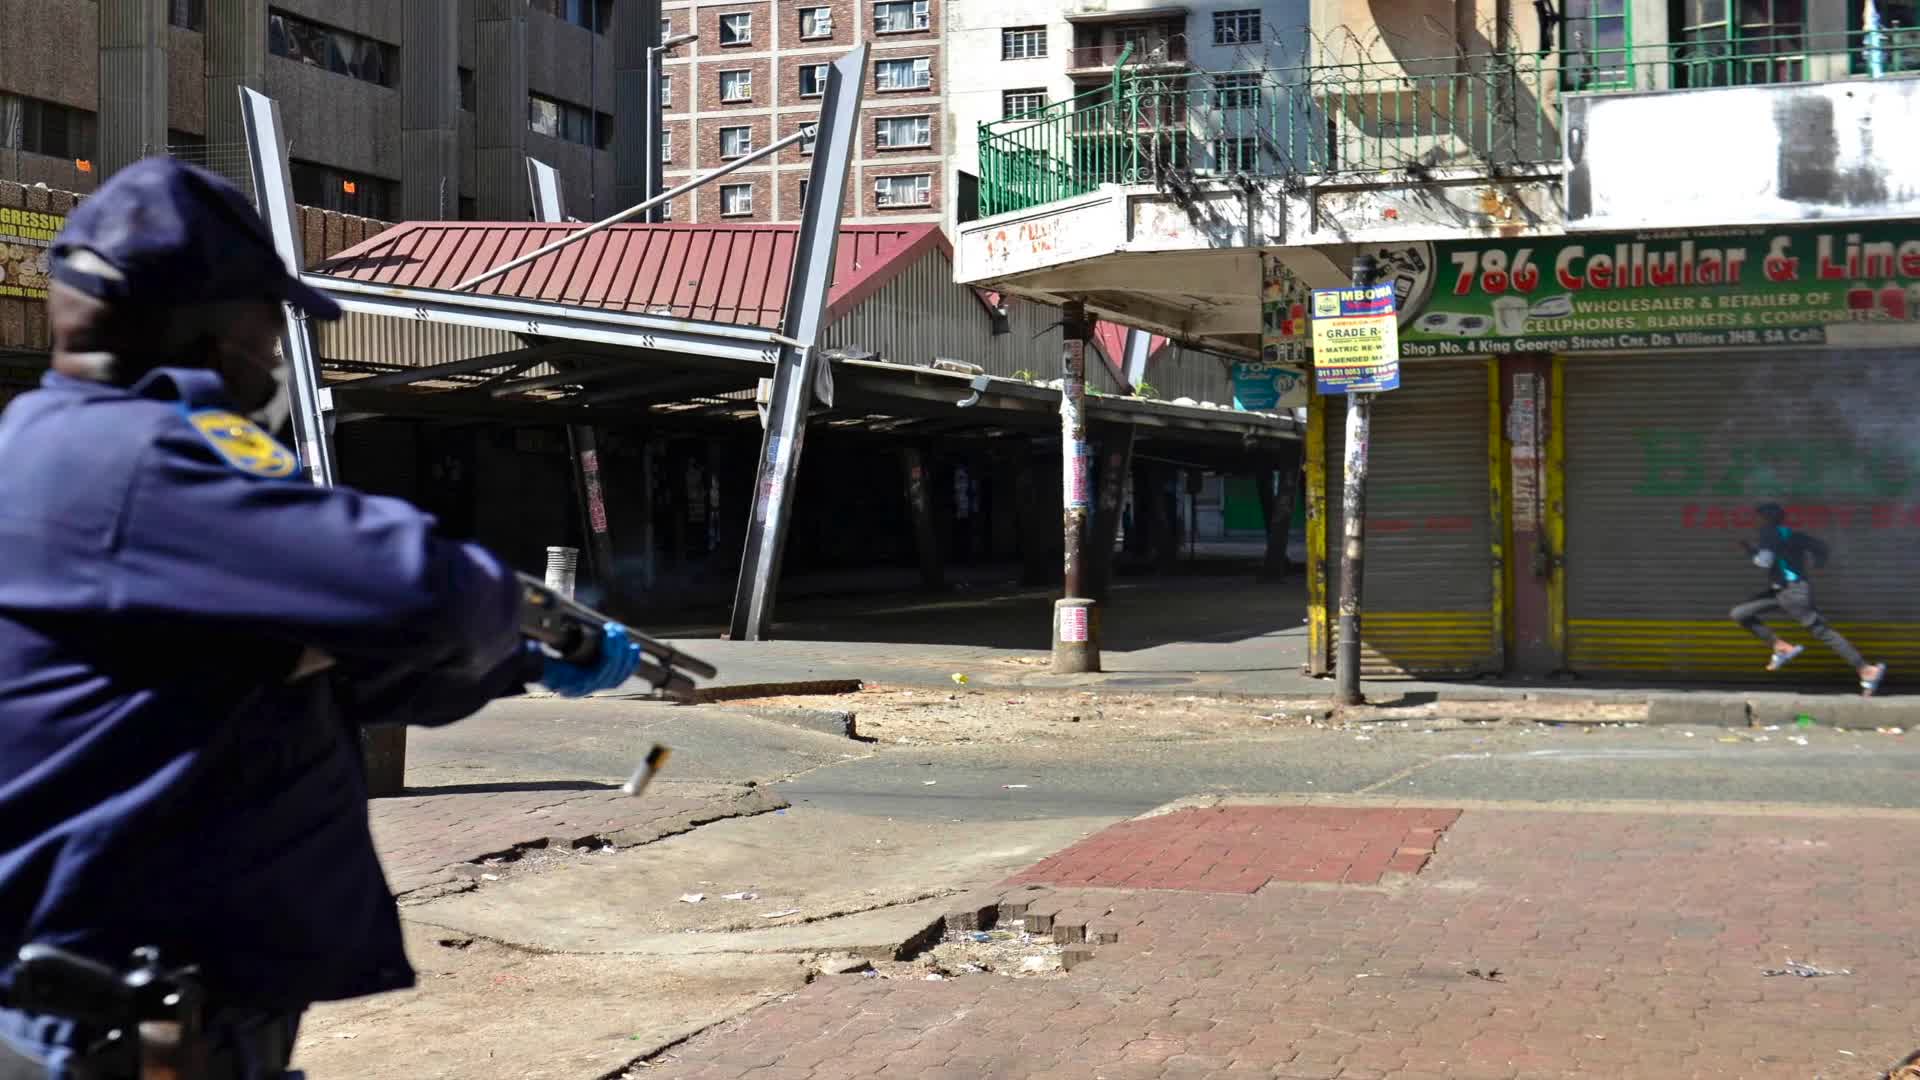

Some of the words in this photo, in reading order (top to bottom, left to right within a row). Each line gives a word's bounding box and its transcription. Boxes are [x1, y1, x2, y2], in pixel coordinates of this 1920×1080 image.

[1451, 249, 1539, 295] 786
[1555, 241, 1747, 289] Cellular
[1764, 235, 1799, 281] &
[1576, 297, 1694, 313] WHOLESALER
[1701, 296, 1713, 309] &
[1719, 294, 1801, 308] RETAILER
[1807, 292, 1832, 305] OF
[1648, 312, 1737, 328] BLANKETS
[1743, 312, 1754, 325] &
[1326, 327, 1367, 339] GRADE
[1326, 345, 1359, 353] MATRIC
[1402, 342, 1437, 356] Shop
[1440, 341, 1464, 353] No.
[1467, 341, 1475, 352] 4
[1480, 339, 1510, 354] King
[1514, 338, 1567, 353] George
[1571, 336, 1615, 349] Street
[1651, 334, 1671, 346] De
[1675, 332, 1726, 345] Villiers
[1764, 329, 1785, 342] SA
[1328, 356, 1369, 364] AMENDED
